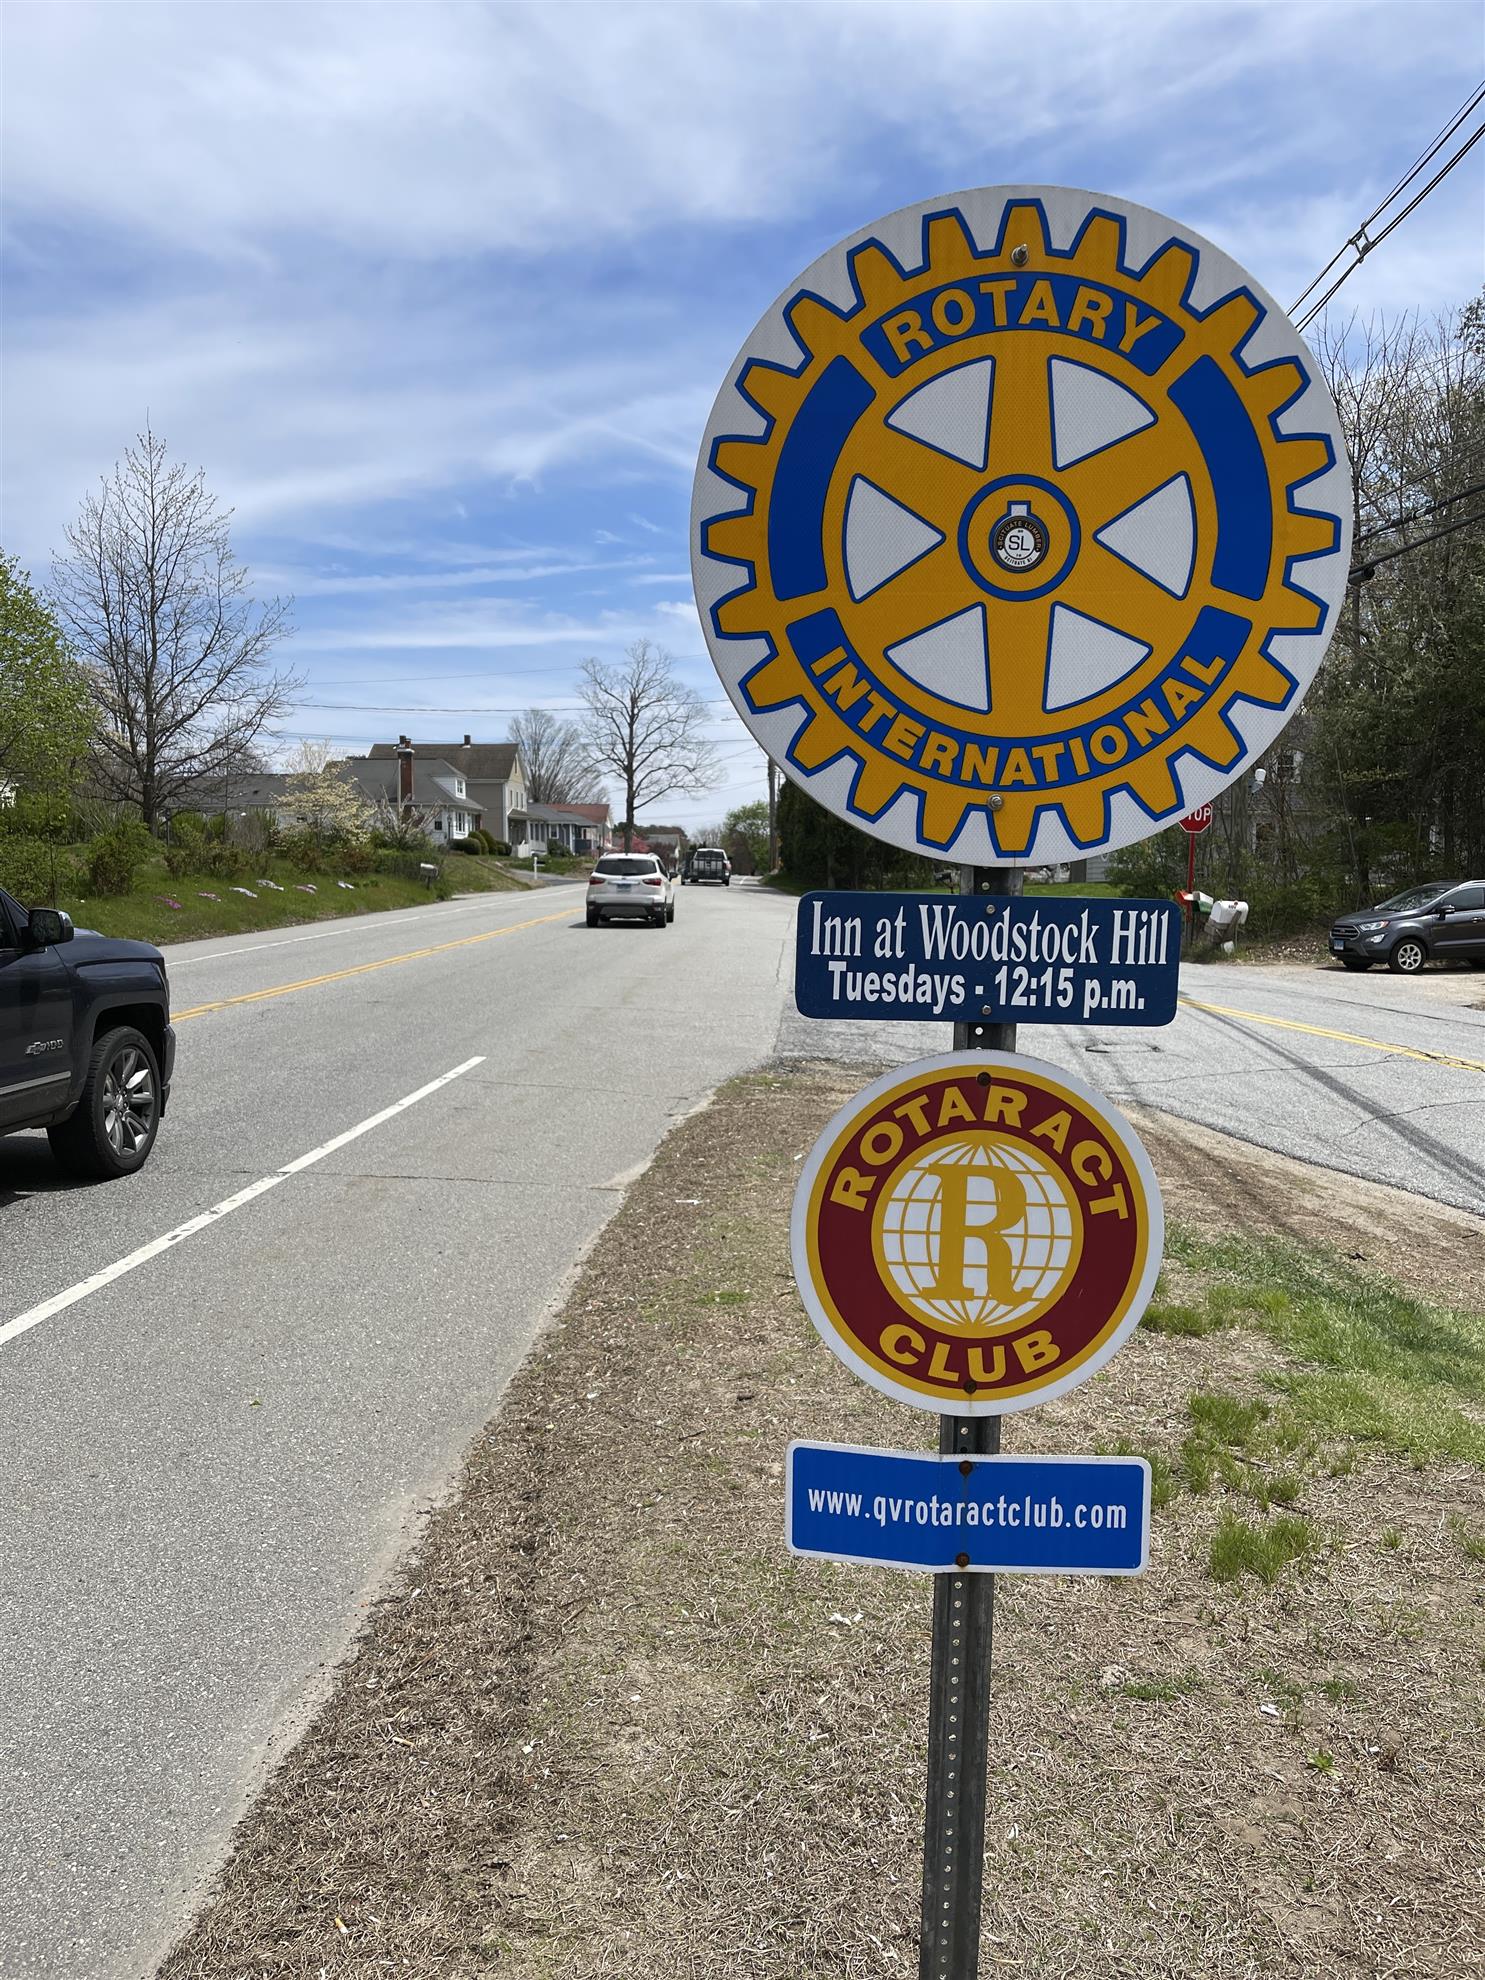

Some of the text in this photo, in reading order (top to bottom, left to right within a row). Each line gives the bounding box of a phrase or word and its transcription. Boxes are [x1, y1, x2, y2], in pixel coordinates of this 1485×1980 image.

[881, 279, 1163, 363] ROTARY
[1008, 535, 1030, 550] SL
[810, 646, 1226, 786] INTERNATIONAL
[1189, 807, 1211, 822] OP
[811, 901, 1169, 965] Inn at Woodstock Hill
[828, 961, 965, 1015] Tuesdays
[995, 966, 1073, 1008] 12:15
[1083, 979, 1145, 1019] p.m.
[830, 1085, 1129, 1220] ROTARACT
[920, 1163, 1036, 1306] R
[879, 1323, 1061, 1383] CLUB
[808, 1488, 1127, 1529] www.qvrotaractclub.com
